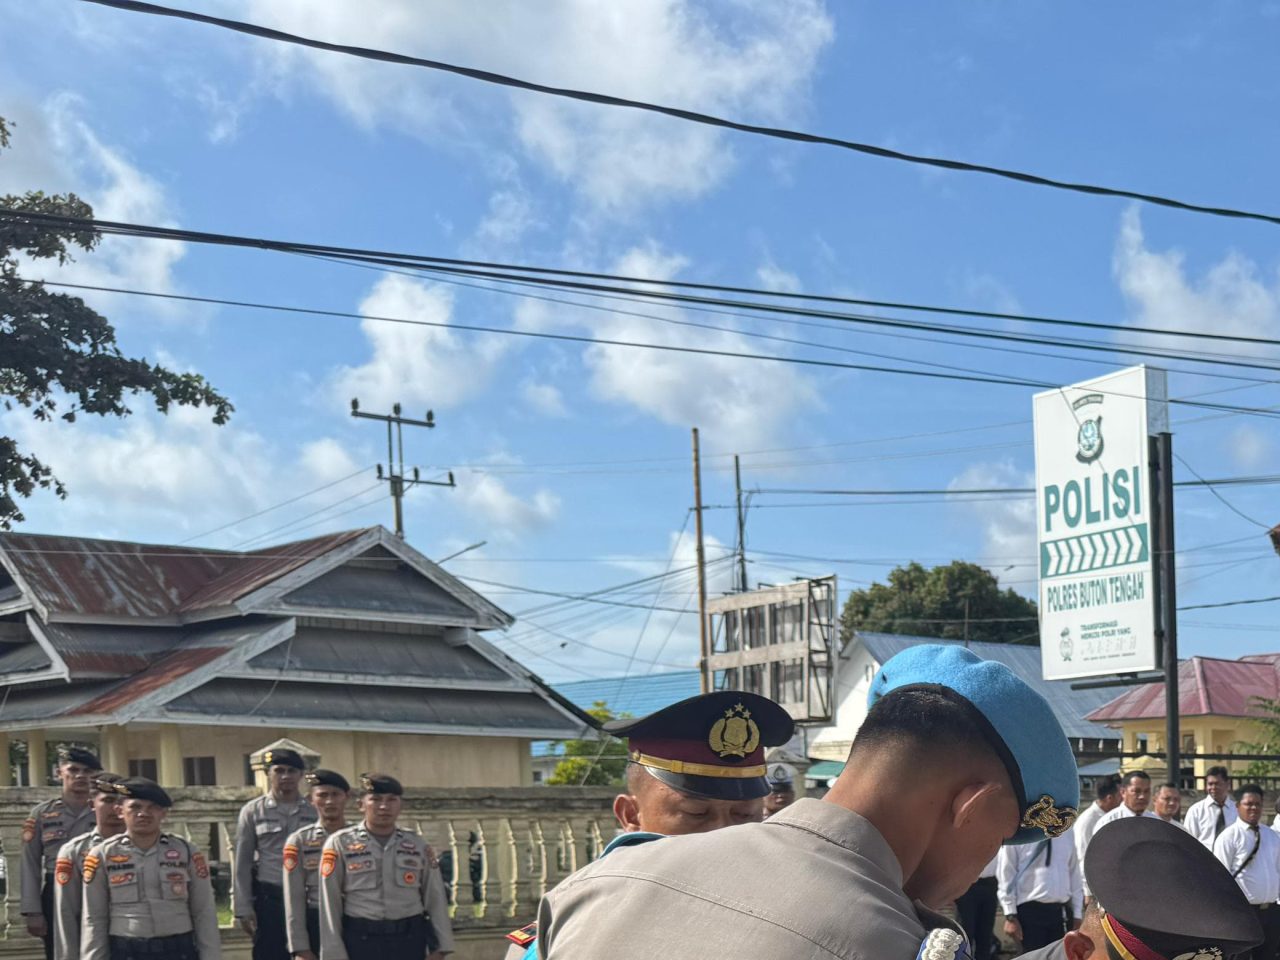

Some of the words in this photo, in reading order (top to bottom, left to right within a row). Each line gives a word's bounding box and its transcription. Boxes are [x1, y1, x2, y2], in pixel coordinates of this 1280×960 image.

[1044, 466, 1141, 532] POLISI
[1047, 583, 1078, 613] POLRES
[1080, 578, 1108, 608] BUTON
[1109, 572, 1145, 604] TENGAH
